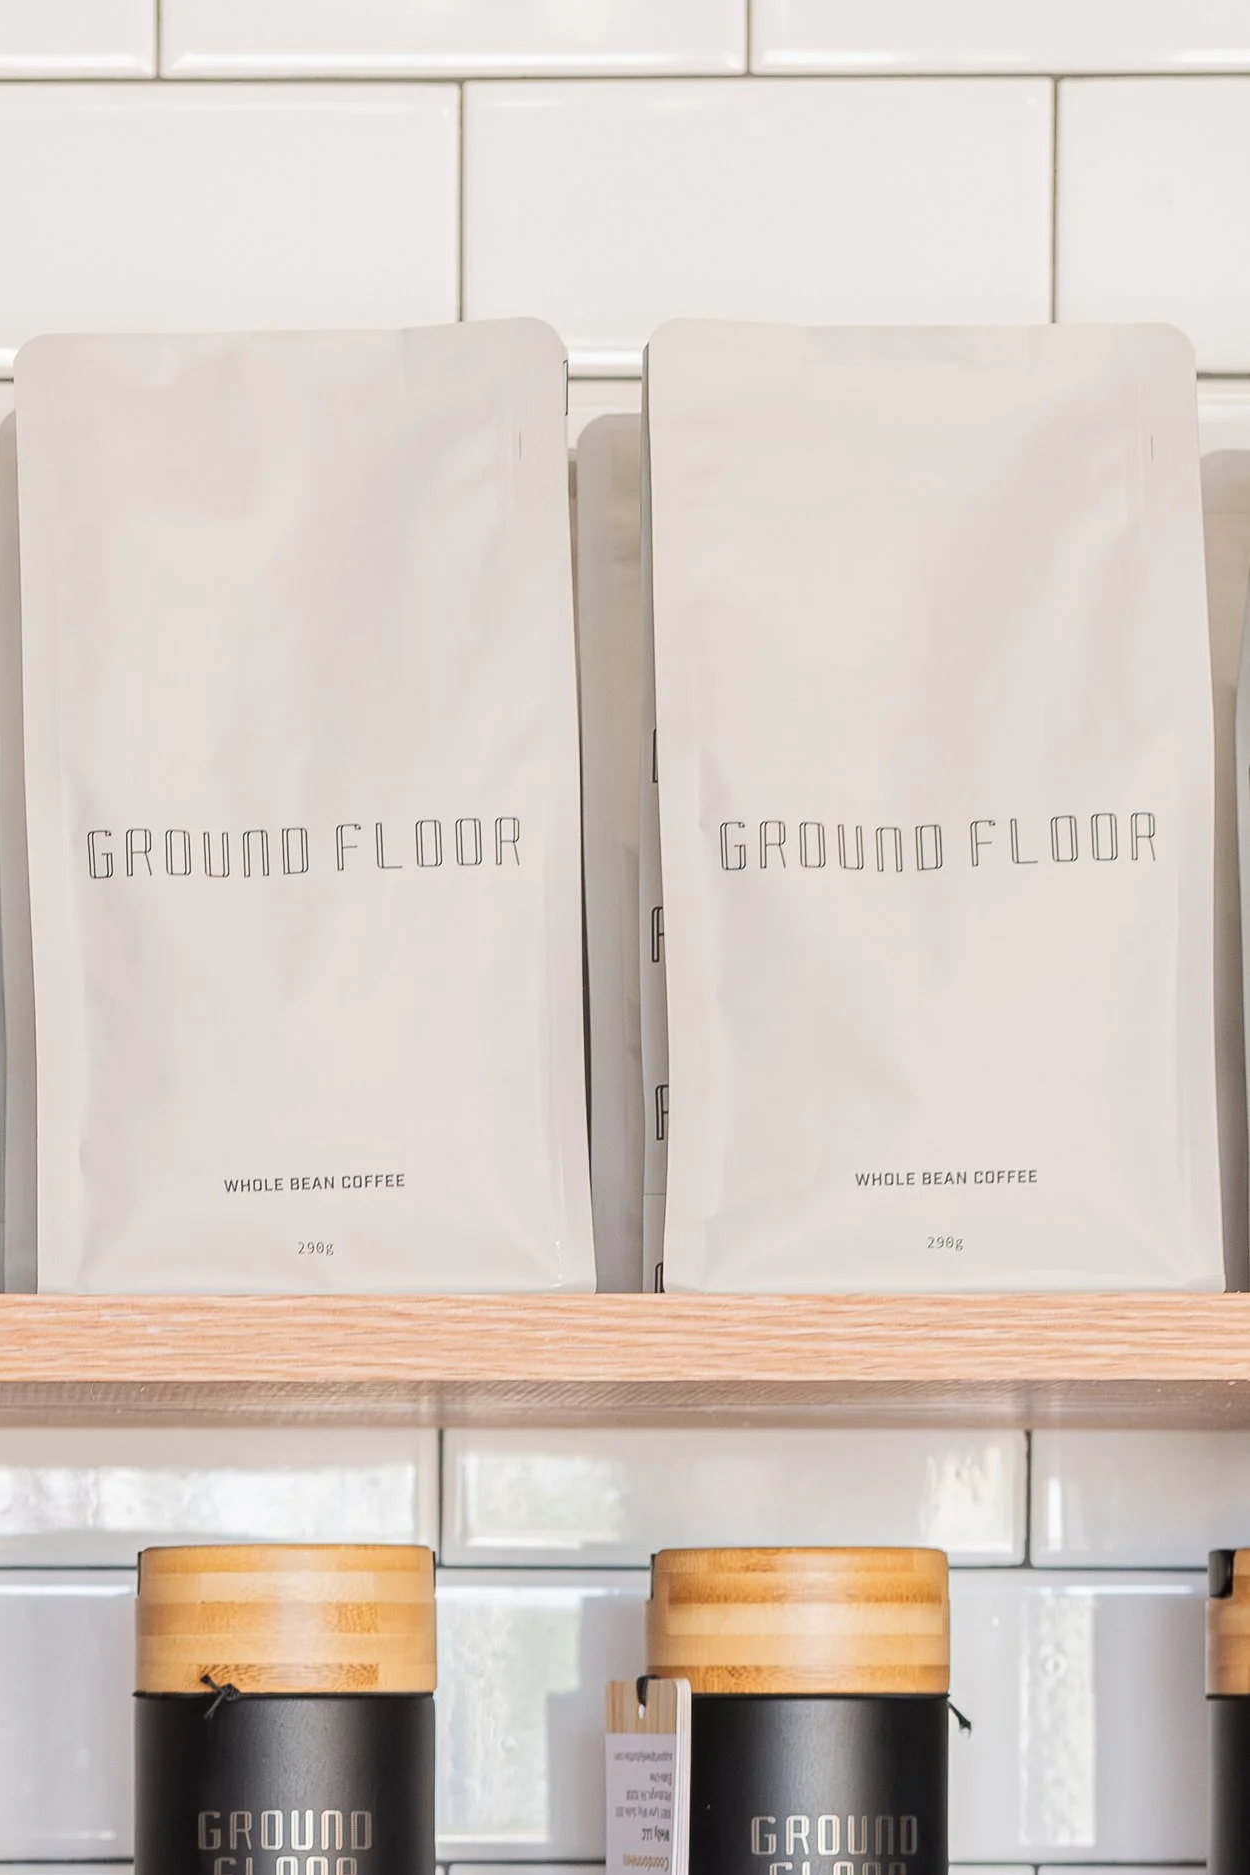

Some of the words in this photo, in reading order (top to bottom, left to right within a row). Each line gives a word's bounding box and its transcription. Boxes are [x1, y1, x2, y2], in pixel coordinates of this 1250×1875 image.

[88, 828, 308, 878] GROUND
[336, 818, 519, 871] FLOOR
[720, 821, 943, 872] GROUND
[970, 813, 1155, 866] FLOOR
[224, 1177, 284, 1193] WHOLE
[290, 1176, 335, 1191] BEAN
[341, 1173, 405, 1189] COFFEE
[855, 1172, 915, 1187] WHOLE
[922, 1171, 967, 1185] BEAN
[973, 1169, 1037, 1184] COFFEE
[298, 1241, 334, 1257] 290g
[927, 1236, 964, 1252] 290g
[199, 1810, 372, 1850] GROUND
[751, 1815, 918, 1856] GROUND
